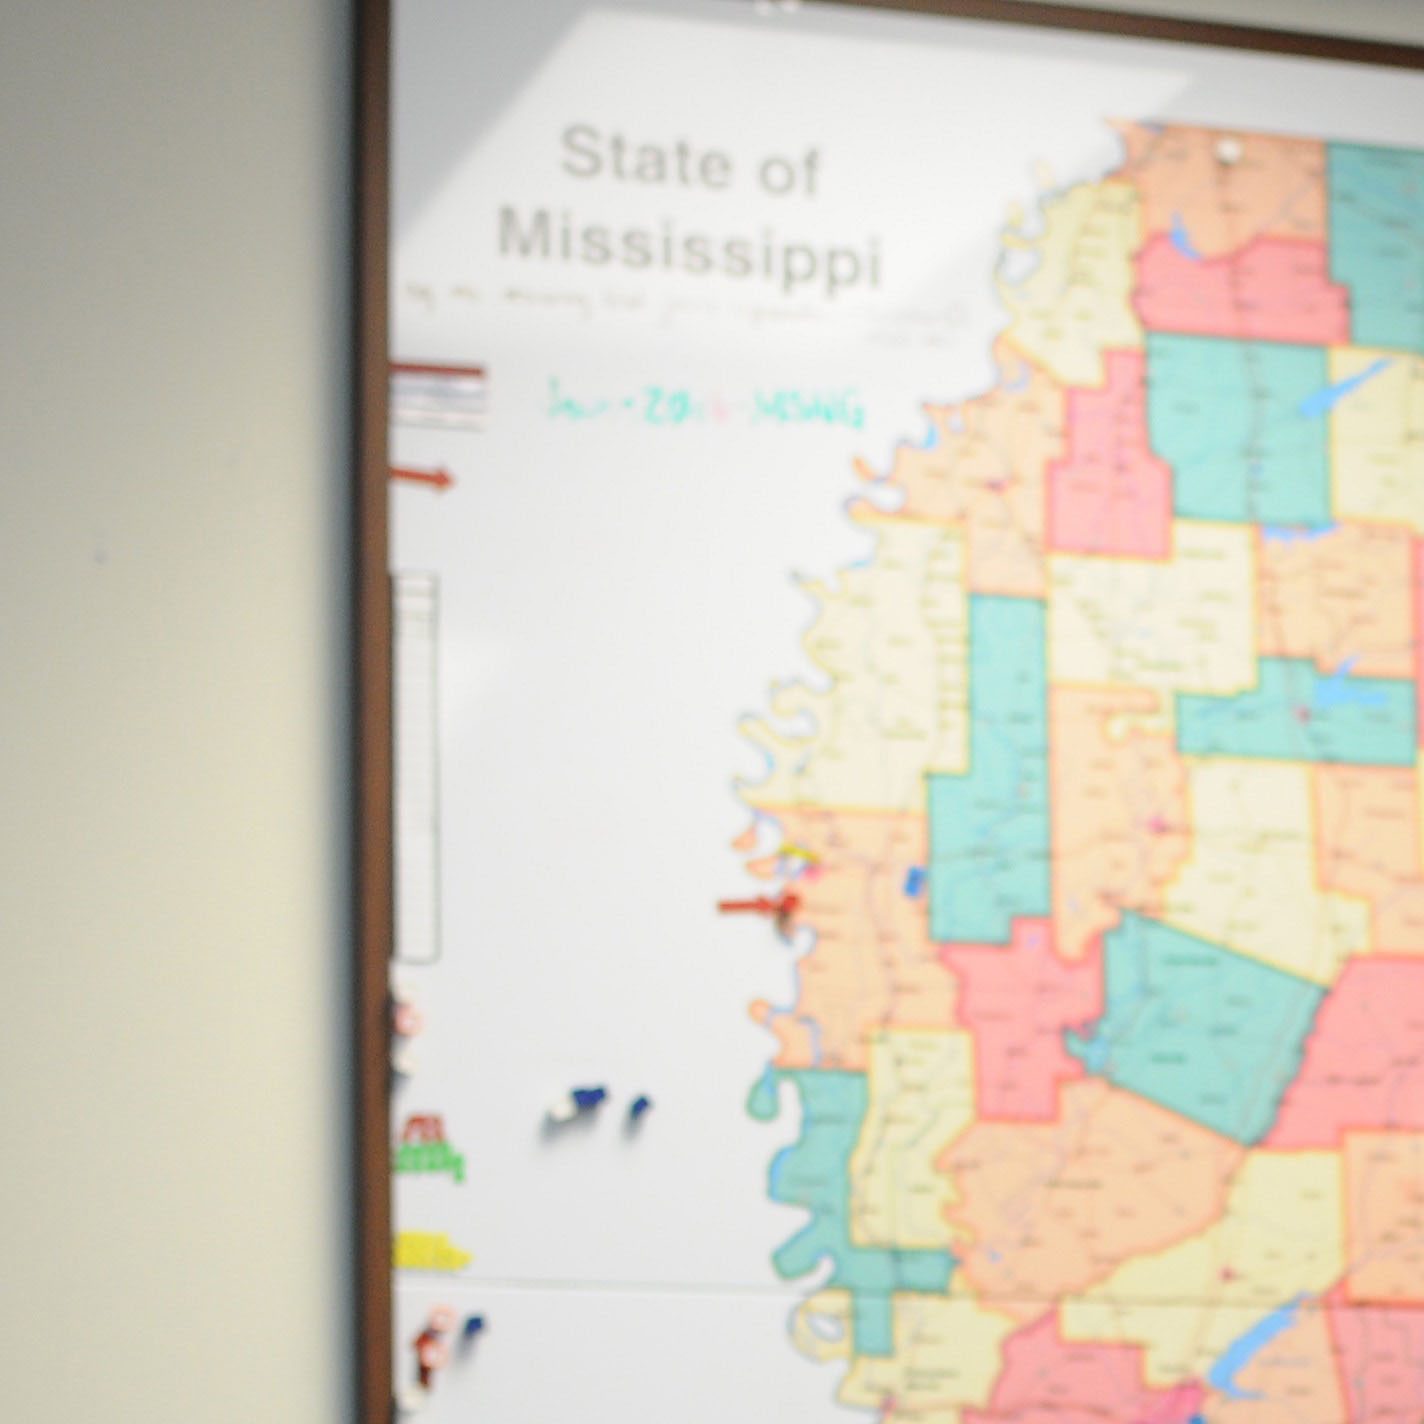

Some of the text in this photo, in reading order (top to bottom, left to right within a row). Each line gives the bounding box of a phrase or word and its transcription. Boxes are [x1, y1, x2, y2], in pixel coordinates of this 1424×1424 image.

[561, 123, 823, 196] State of
[498, 205, 882, 296] Mississippi
